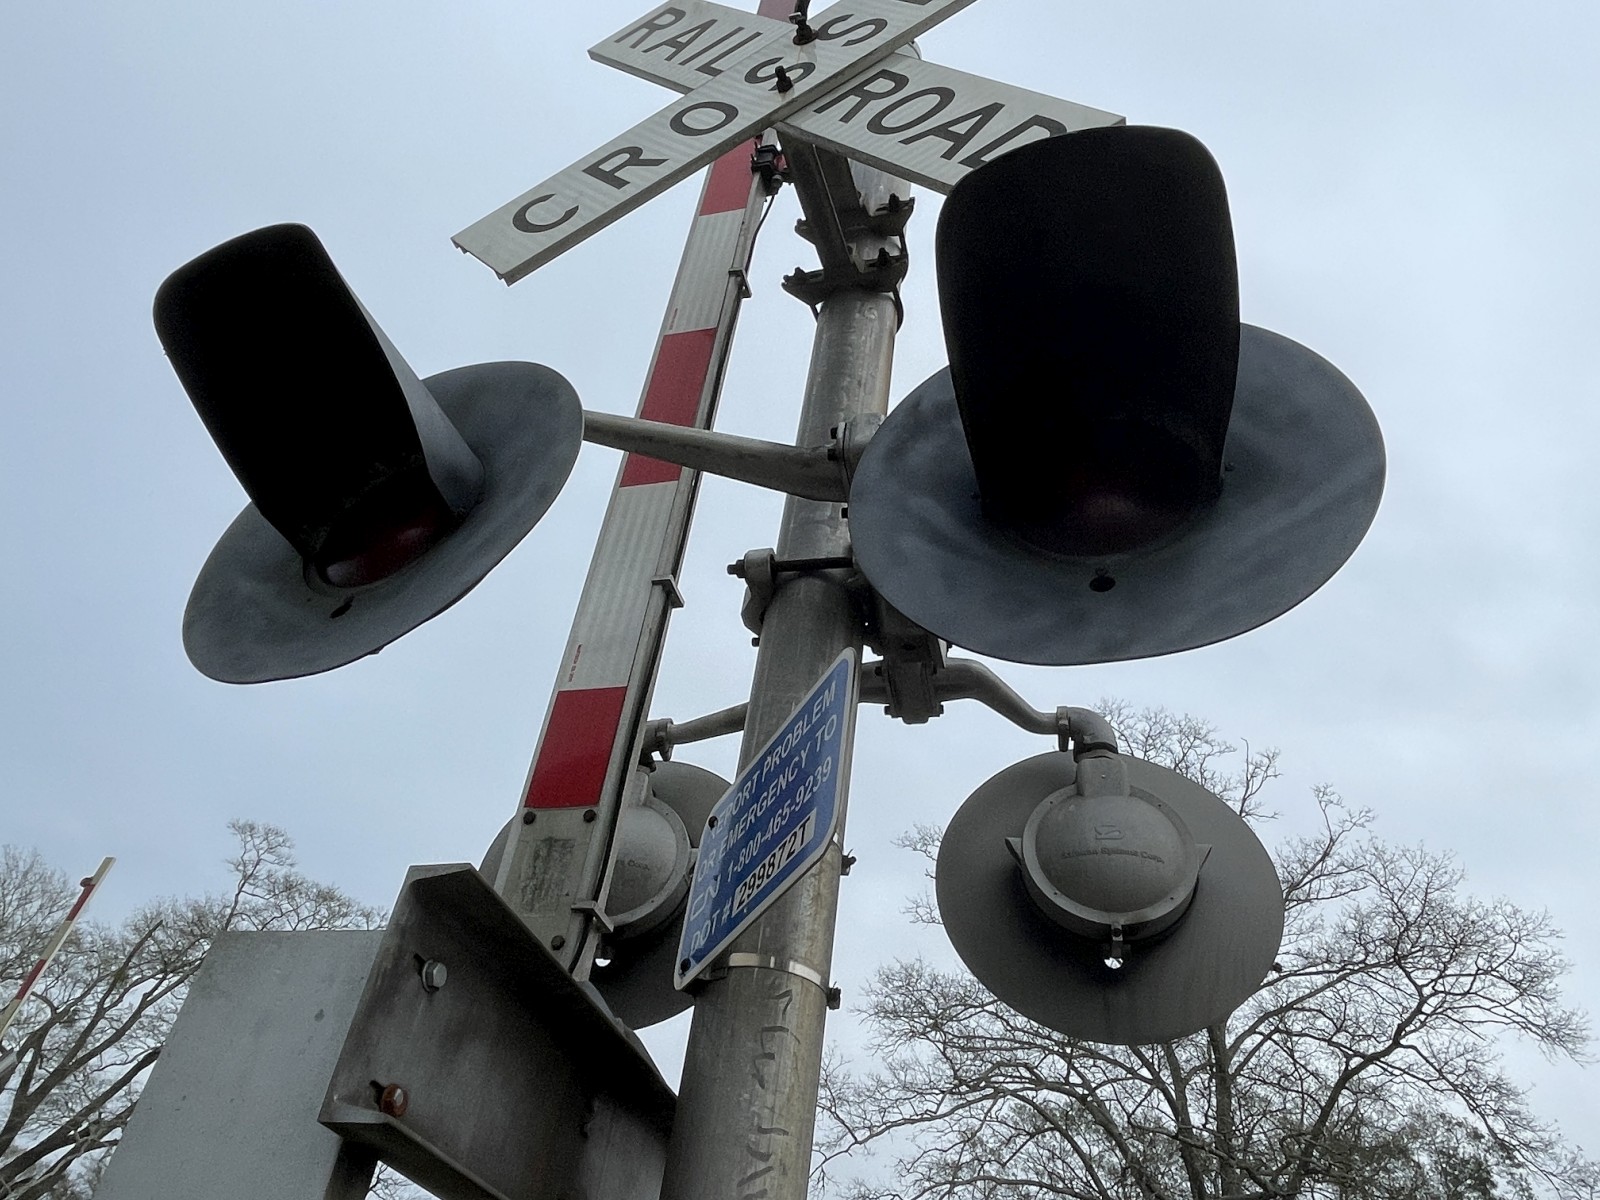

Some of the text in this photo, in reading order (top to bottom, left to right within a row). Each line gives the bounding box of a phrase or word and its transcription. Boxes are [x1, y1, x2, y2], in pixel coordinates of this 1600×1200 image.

[512, 0, 933, 233] CROSS
[614, 7, 1067, 168] RAIL ROAD
[698, 714, 838, 882] OR EMERGENCY TO
[762, 680, 836, 783] PROBLEM
[690, 756, 832, 921] CN 1-800-465-9239
[690, 909, 720, 957] DOT
[736, 815, 812, 911] 299872T
